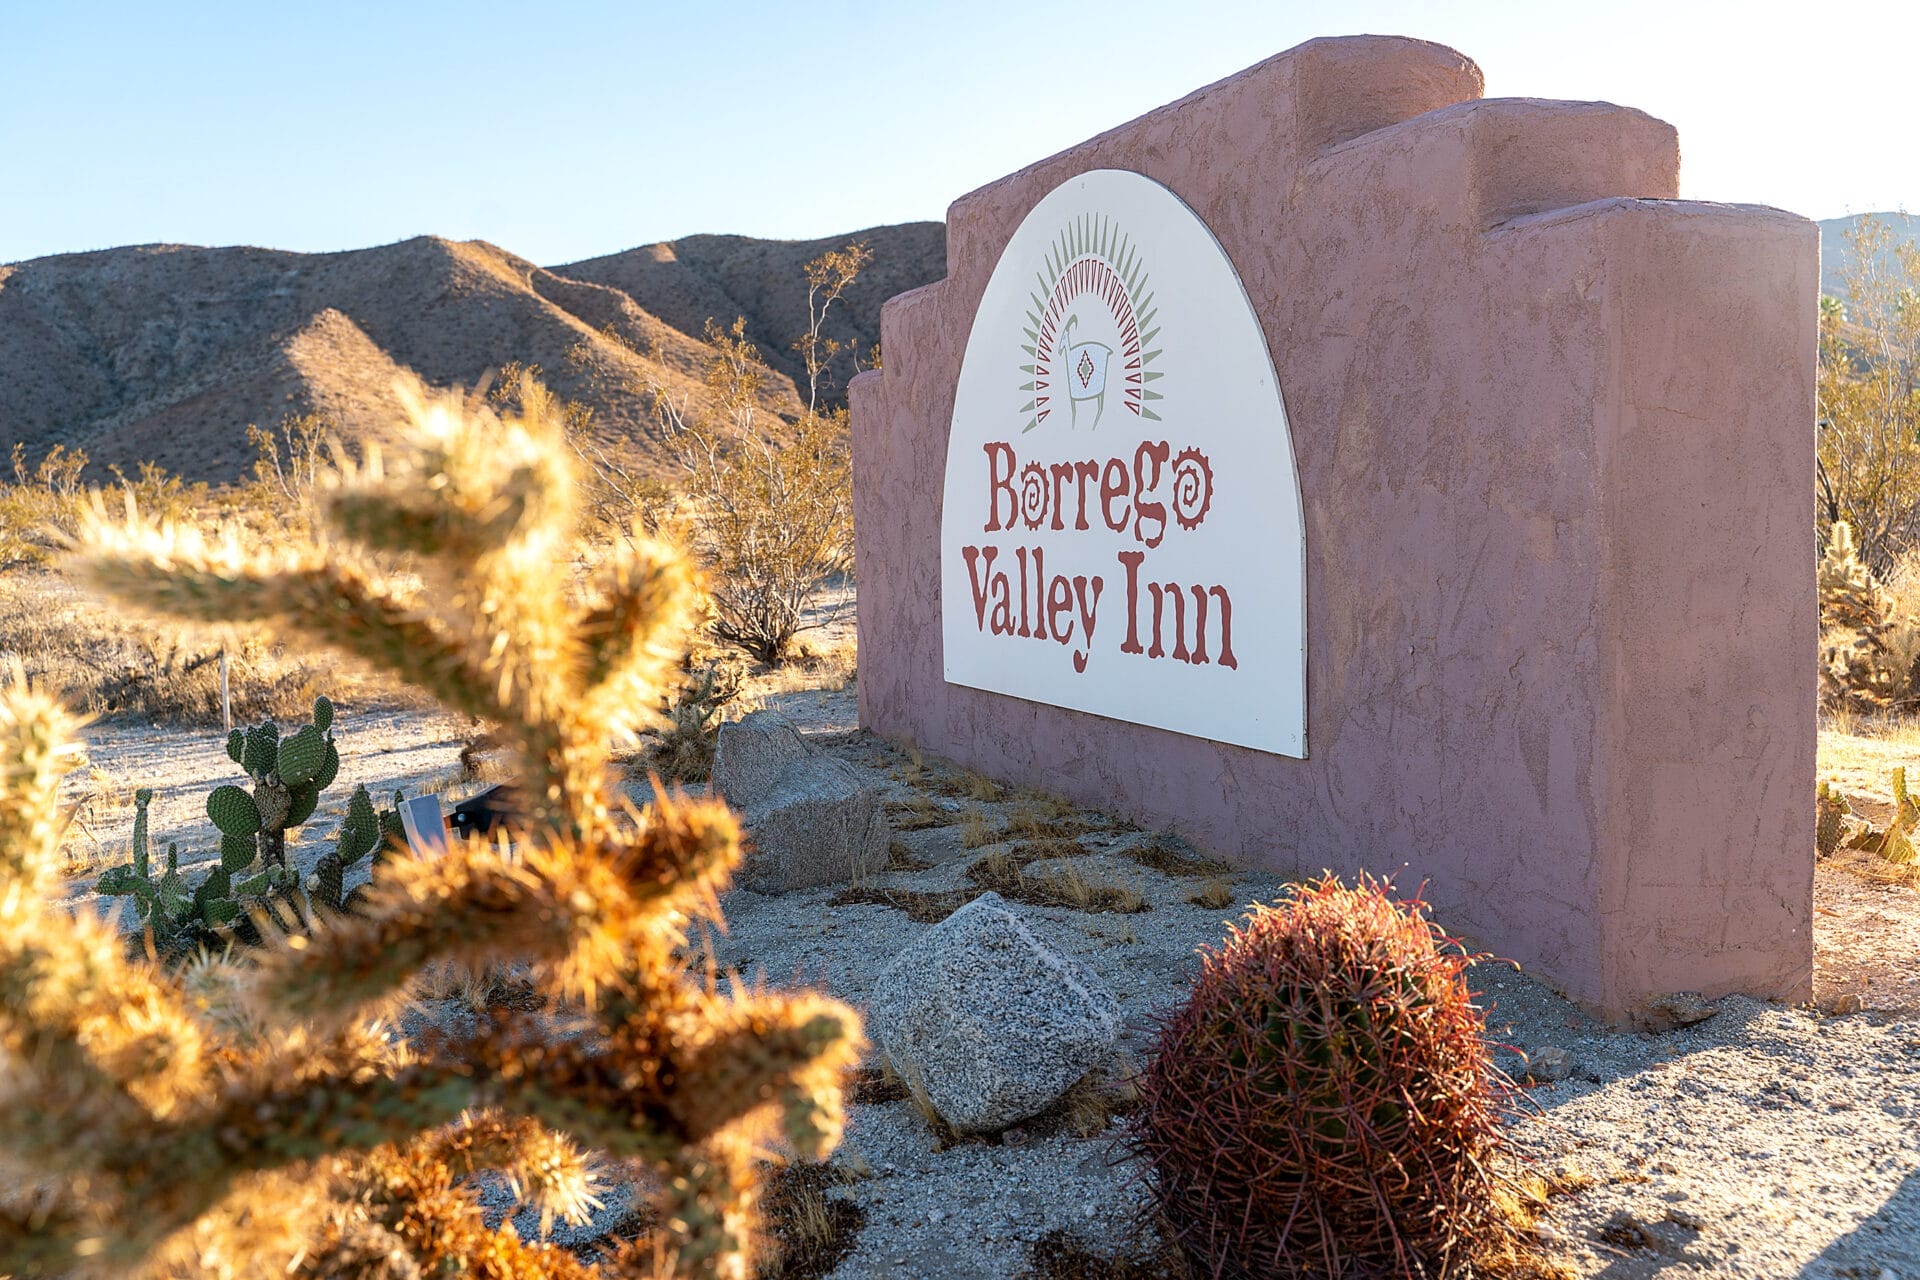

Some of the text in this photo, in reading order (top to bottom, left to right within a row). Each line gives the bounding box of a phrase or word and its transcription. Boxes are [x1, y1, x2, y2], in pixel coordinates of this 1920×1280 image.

[983, 441, 1214, 549] Borrego
[962, 545, 1238, 673] Valley Inn
